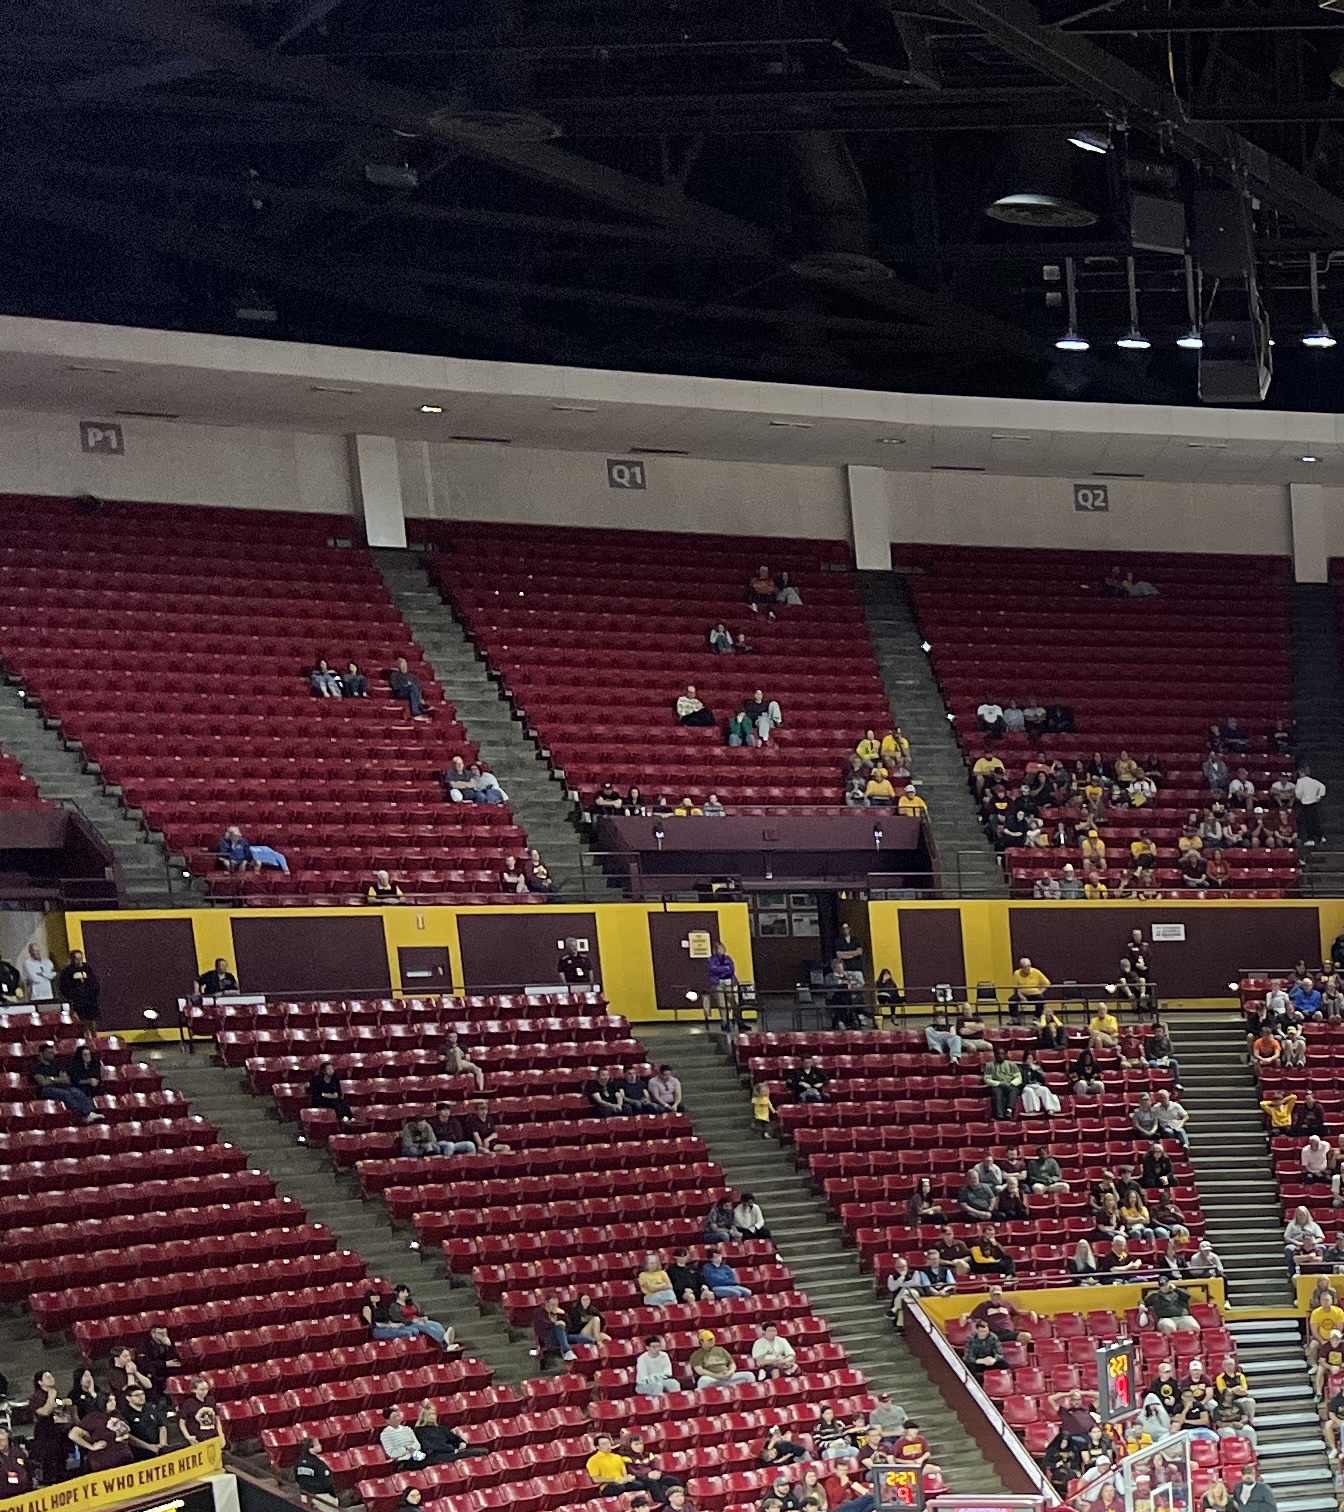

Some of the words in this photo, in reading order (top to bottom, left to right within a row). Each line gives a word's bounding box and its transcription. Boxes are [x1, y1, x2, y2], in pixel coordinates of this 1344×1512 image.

[87, 425, 118, 451] P1
[611, 463, 643, 487] Q1
[1077, 489, 1106, 510] Q2
[51, 1488, 79, 1509] HOPE
[82, 1482, 98, 1500] YE
[103, 1475, 135, 1494] WHO
[138, 1462, 175, 1485] ENTER
[179, 1452, 204, 1473] HERE
[886, 1471, 917, 1486] 2:27
